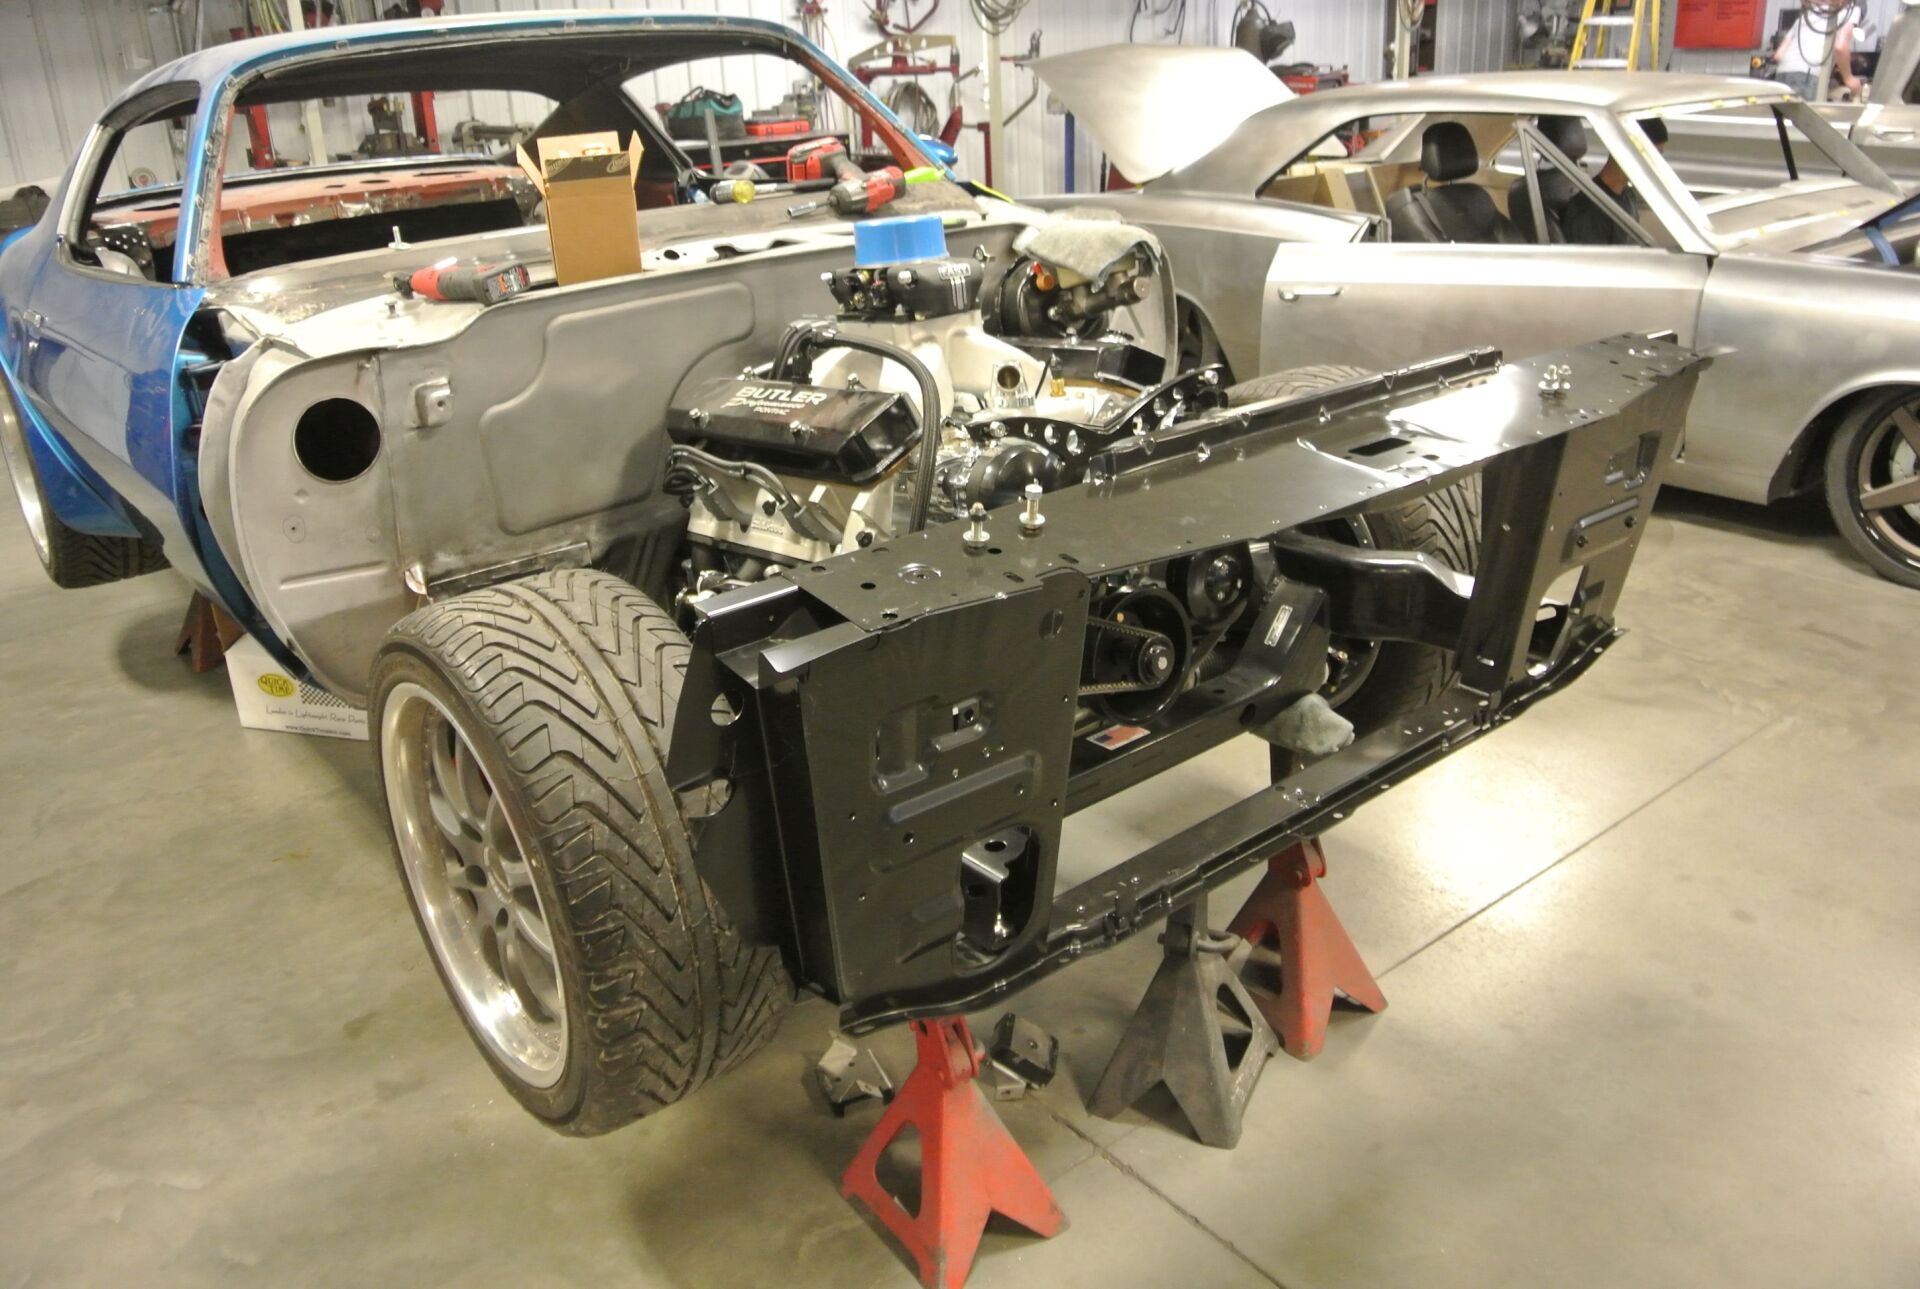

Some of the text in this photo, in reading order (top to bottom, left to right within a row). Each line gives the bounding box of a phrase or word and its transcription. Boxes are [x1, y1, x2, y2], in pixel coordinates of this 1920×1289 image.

[736, 386, 828, 406] BUTLER
[260, 676, 288, 689] QUICK
[270, 684, 290, 695] TIME
